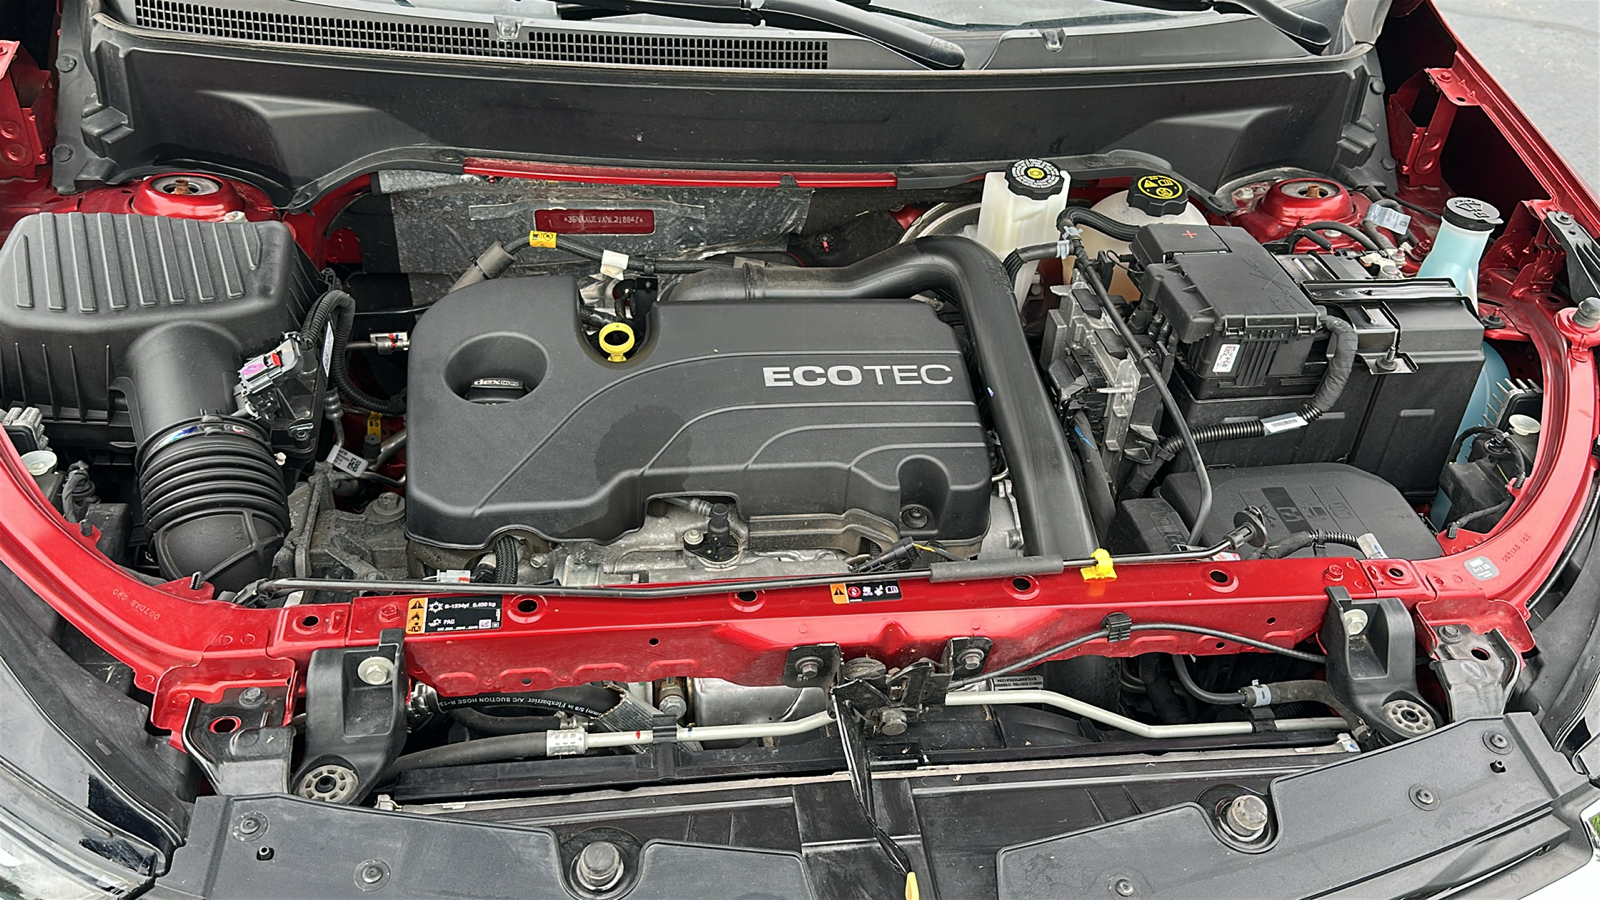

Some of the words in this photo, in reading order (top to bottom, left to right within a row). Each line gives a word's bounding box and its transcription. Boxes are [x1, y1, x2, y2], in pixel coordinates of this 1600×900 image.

[762, 364, 954, 387] ECOTEC
[458, 697, 477, 705] HOSE
[527, 697, 567, 709] Flexbarrier
